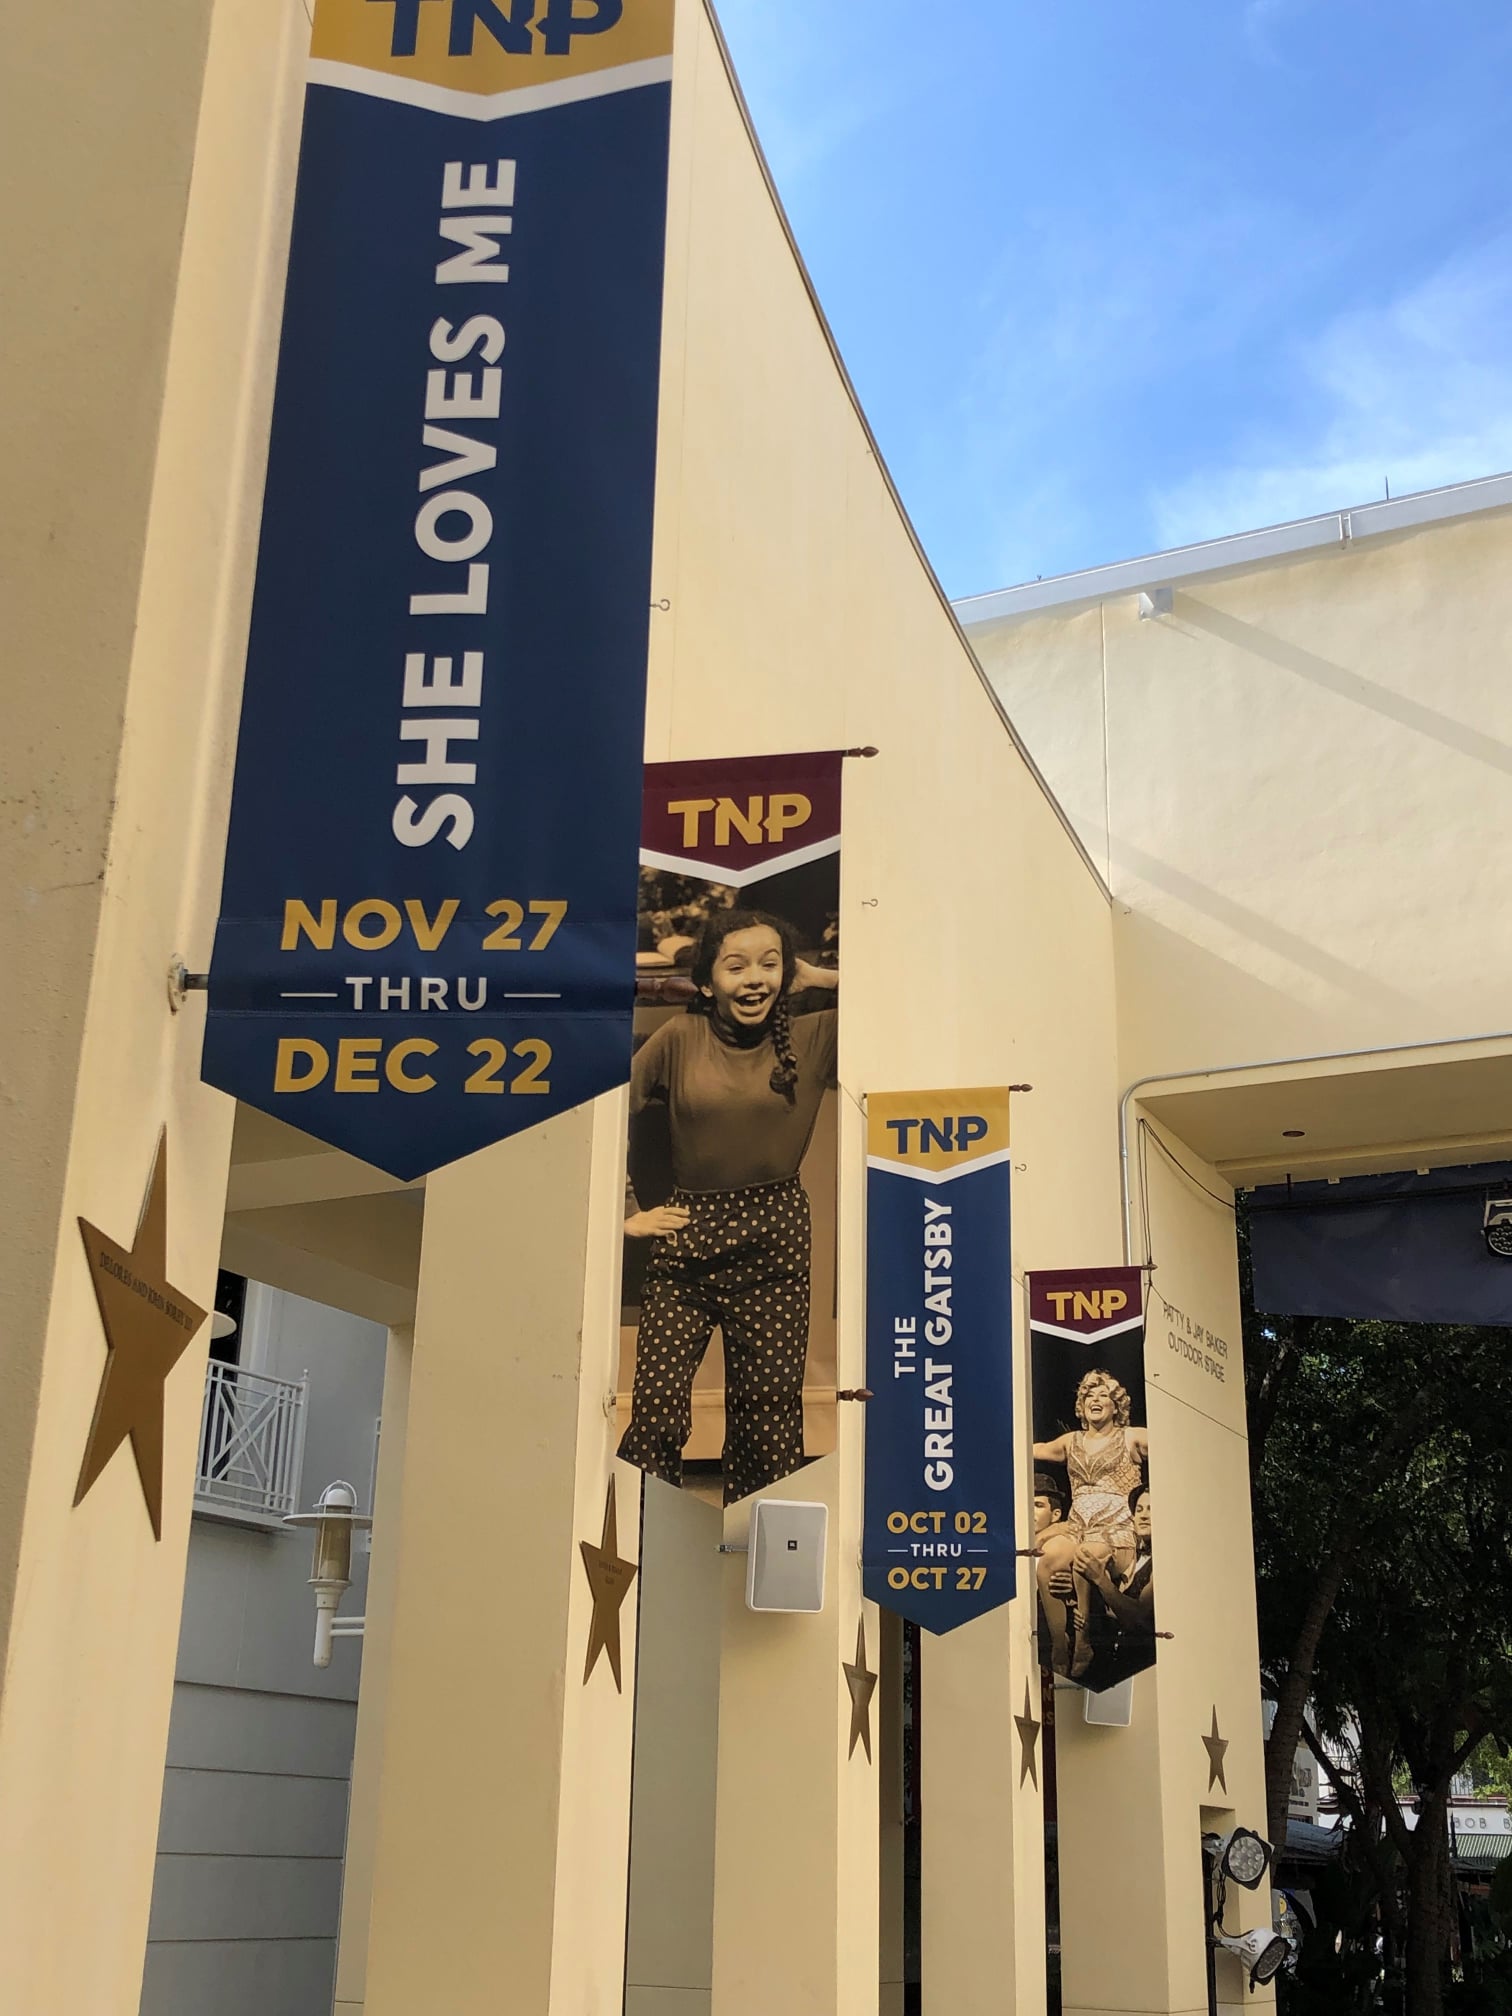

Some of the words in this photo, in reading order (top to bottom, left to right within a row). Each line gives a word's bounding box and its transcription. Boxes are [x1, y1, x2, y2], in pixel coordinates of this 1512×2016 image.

[365, 0, 623, 56] TNP
[435, 158, 517, 285] ME
[409, 313, 506, 615] LOVES
[391, 651, 484, 851] SHE
[667, 793, 812, 848] TNP
[280, 898, 461, 951] NOV
[482, 898, 568, 951] 27
[345, 976, 487, 1011] THRU
[273, 1037, 440, 1094] DEC
[464, 1037, 552, 1094] 22
[886, 1116, 988, 1154] TNP
[132, 1279, 148, 1298] AND
[924, 1197, 953, 1346] GATSBY
[1046, 1289, 1128, 1320] TNP
[1163, 1303, 1185, 1330] PATTY
[1205, 1330, 1228, 1360] BAKER
[894, 1316, 916, 1379] THE
[1168, 1331, 1203, 1369] OUTDOOR
[1204, 1355, 1225, 1383] STAGE
[924, 1357, 954, 1491] GREAT
[886, 1511, 946, 1534] OCT
[954, 1511, 987, 1534] 02
[910, 1543, 962, 1557] THRU
[887, 1566, 947, 1590] OCT
[955, 1566, 987, 1590] 27
